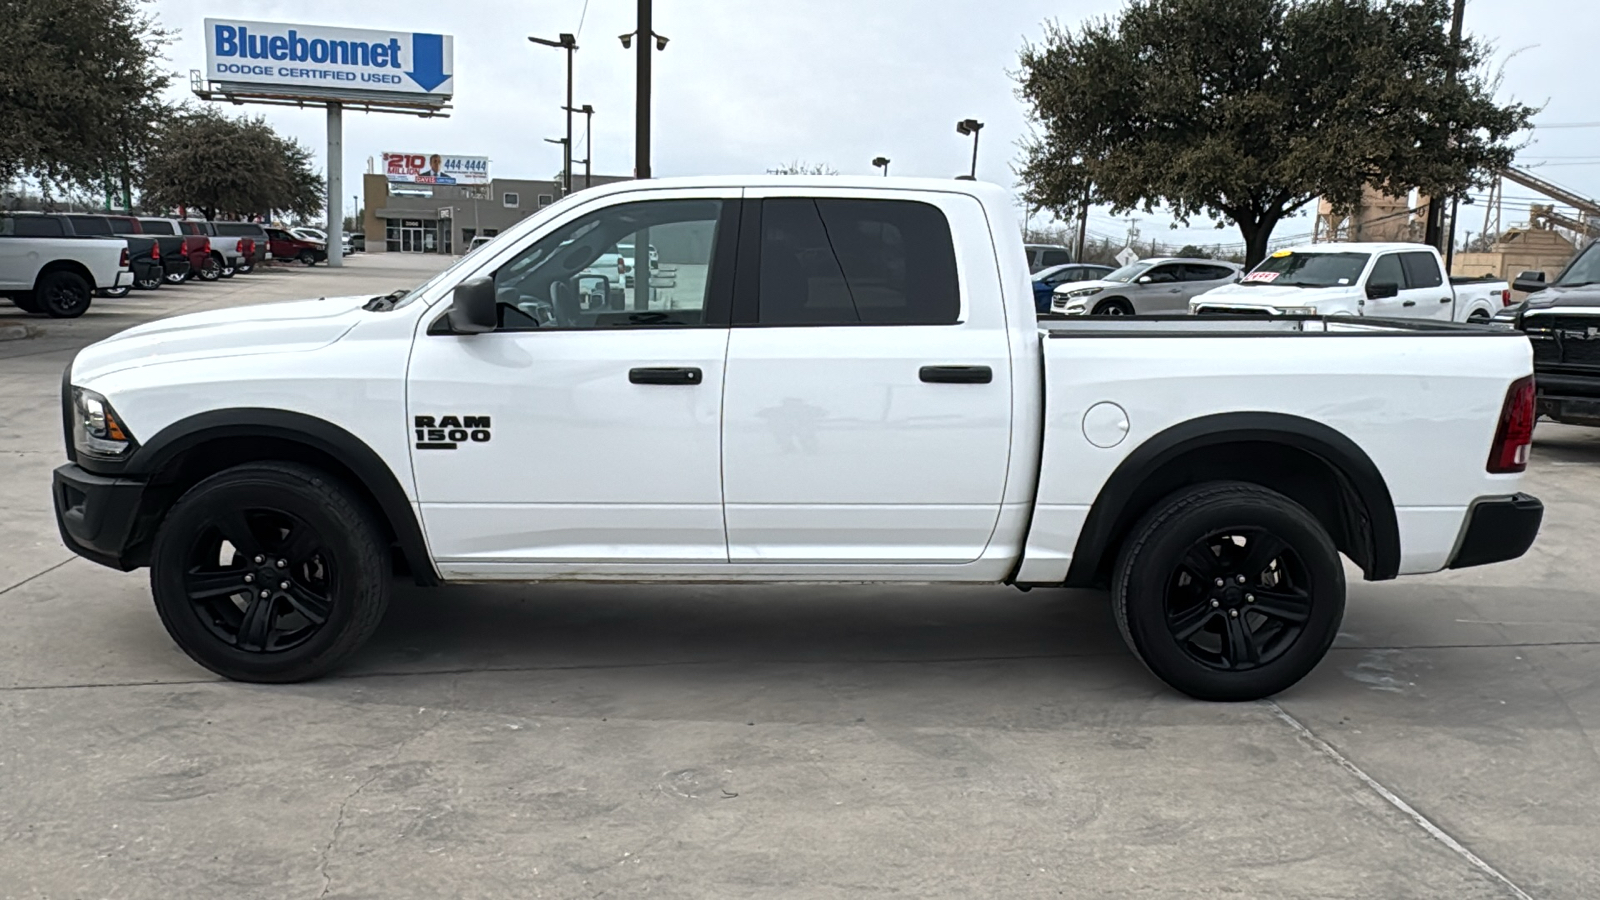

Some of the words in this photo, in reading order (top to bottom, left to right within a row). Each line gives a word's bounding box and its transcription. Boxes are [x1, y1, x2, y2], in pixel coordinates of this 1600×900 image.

[214, 24, 402, 68] Bluebonnet
[217, 63, 274, 76] DODGE
[278, 67, 357, 81] CERTIFIED
[360, 72, 402, 84] USED
[444, 159, 486, 171] 444-4444
[387, 167, 421, 176] MILLION
[417, 176, 436, 184] DAVIS
[415, 416, 490, 428] RAM
[415, 429, 491, 442] 1500
